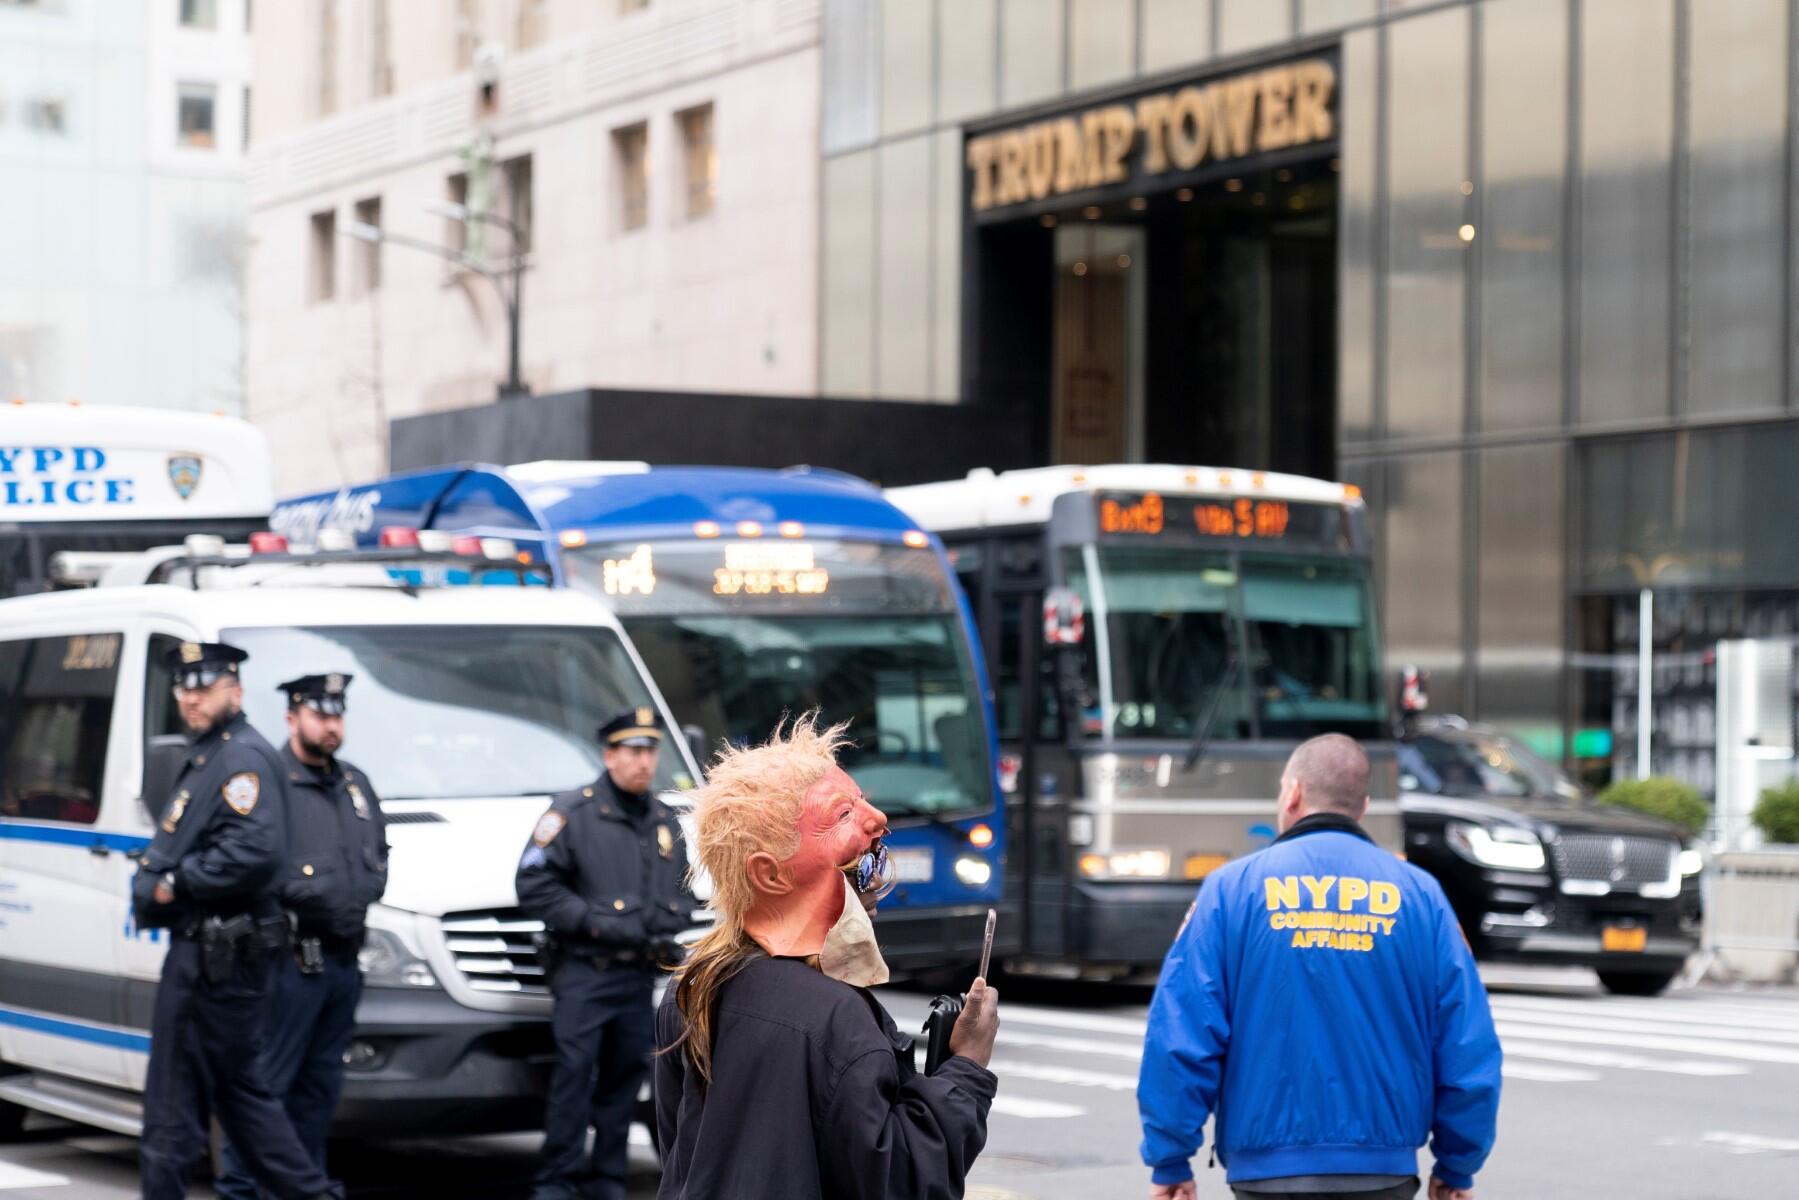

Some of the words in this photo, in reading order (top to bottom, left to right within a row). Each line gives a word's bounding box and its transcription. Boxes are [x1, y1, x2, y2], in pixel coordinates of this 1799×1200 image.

[967, 104, 1135, 209] TRUMP
[1137, 58, 1334, 175] TOWER
[0, 446, 106, 473] YPD
[4, 480, 134, 504] LICE
[1235, 497, 1253, 538] 5
[1264, 876, 1401, 915] NYPD
[1270, 911, 1396, 936] COMMUNITY
[1291, 930, 1374, 951] AFFAIRS
